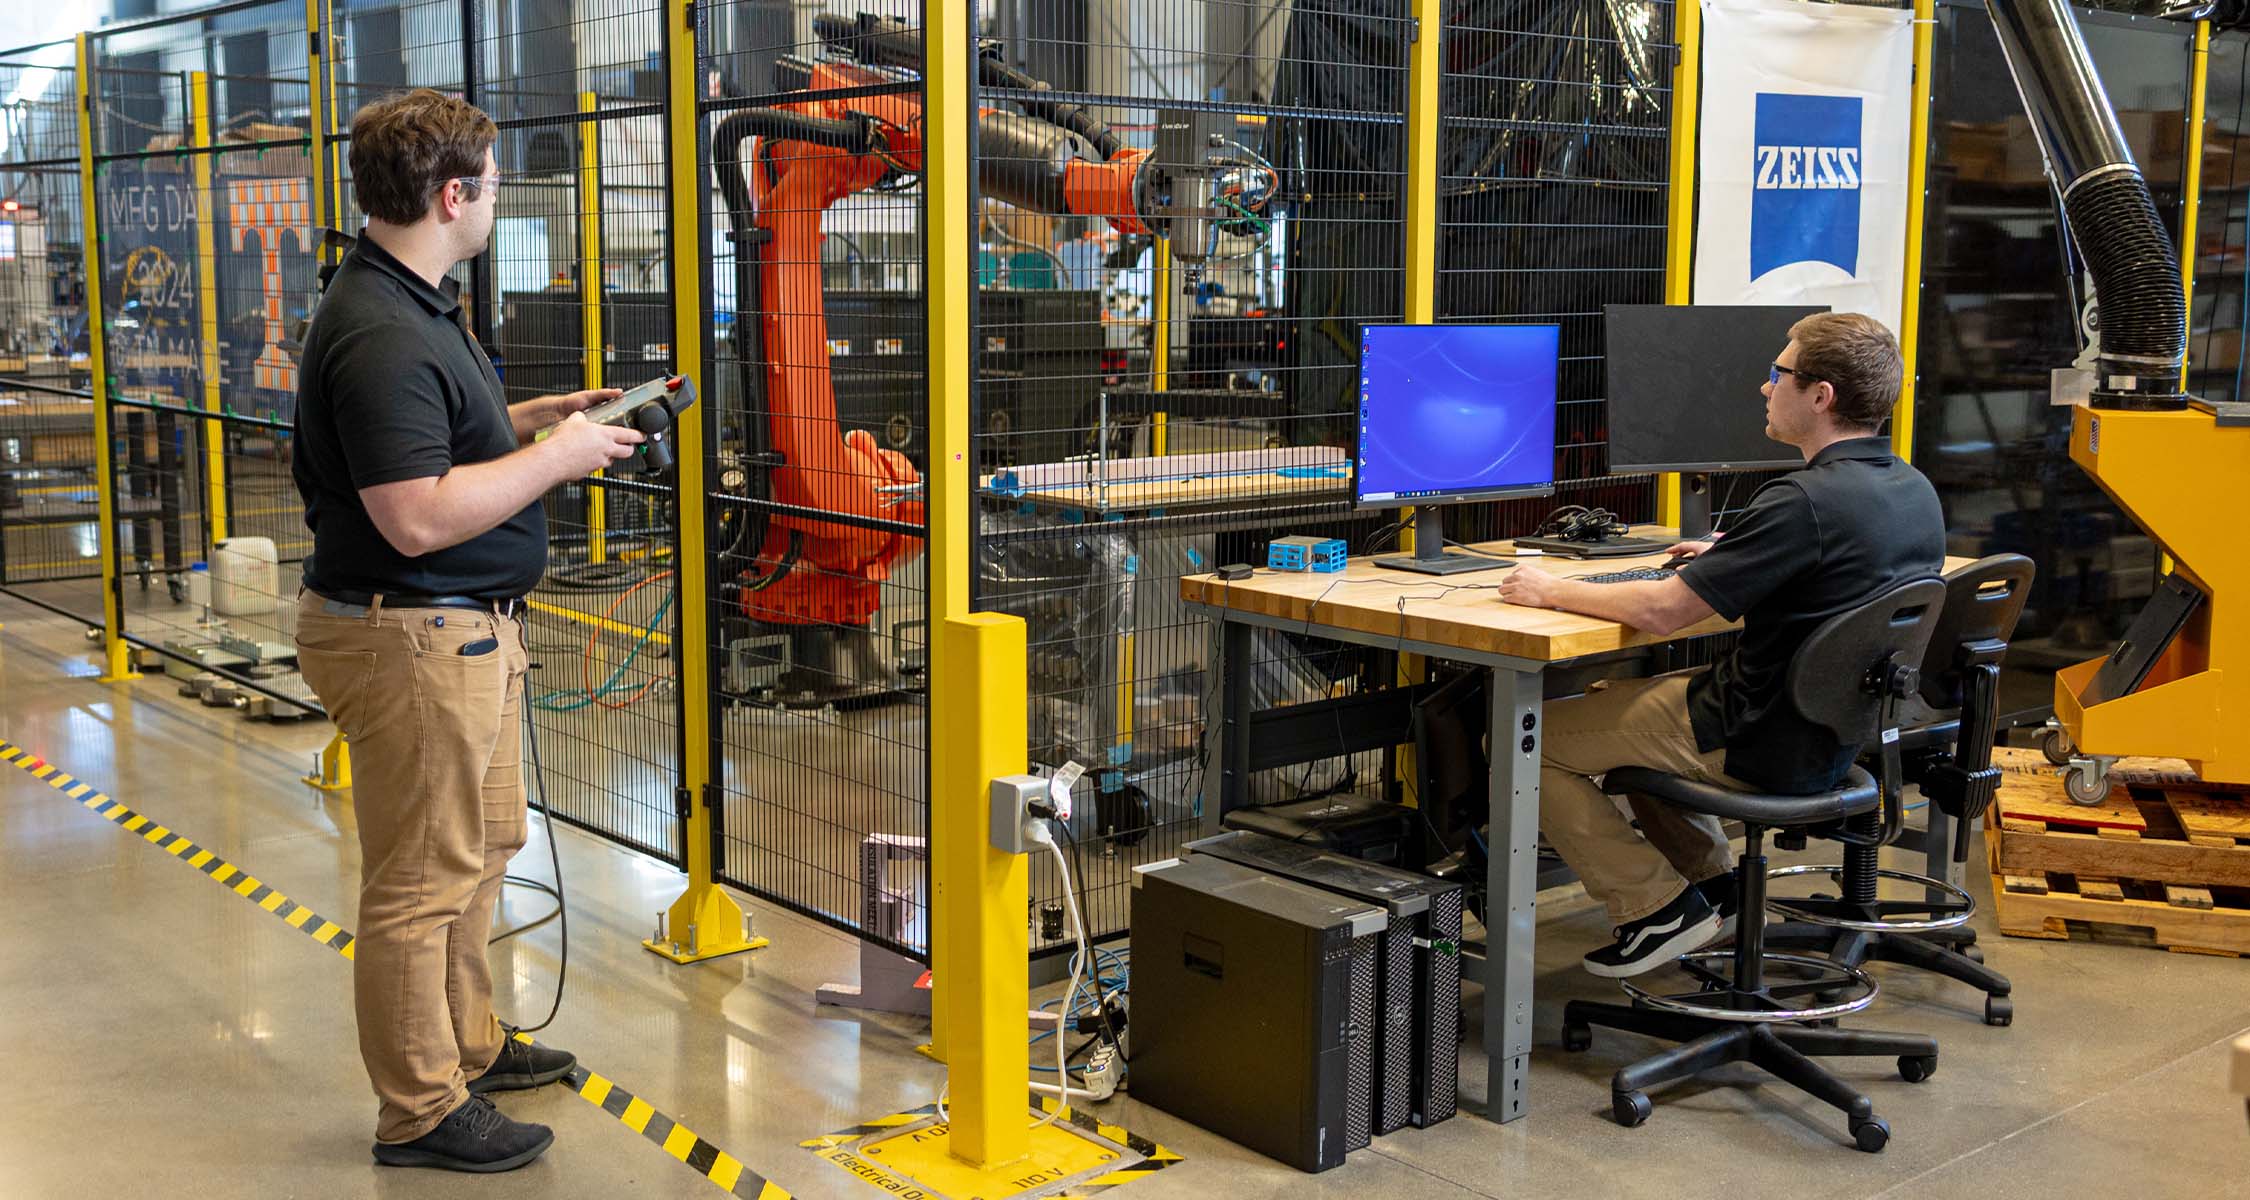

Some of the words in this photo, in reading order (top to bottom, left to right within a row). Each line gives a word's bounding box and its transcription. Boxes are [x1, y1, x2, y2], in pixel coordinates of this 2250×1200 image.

[1756, 145, 1860, 190] ZEISS
[111, 184, 160, 233] MFG
[139, 260, 195, 310] 2024
[831, 1152, 910, 1193] Electrical
[1011, 1174, 1048, 1189] 110
[1045, 1167, 1064, 1176] V
